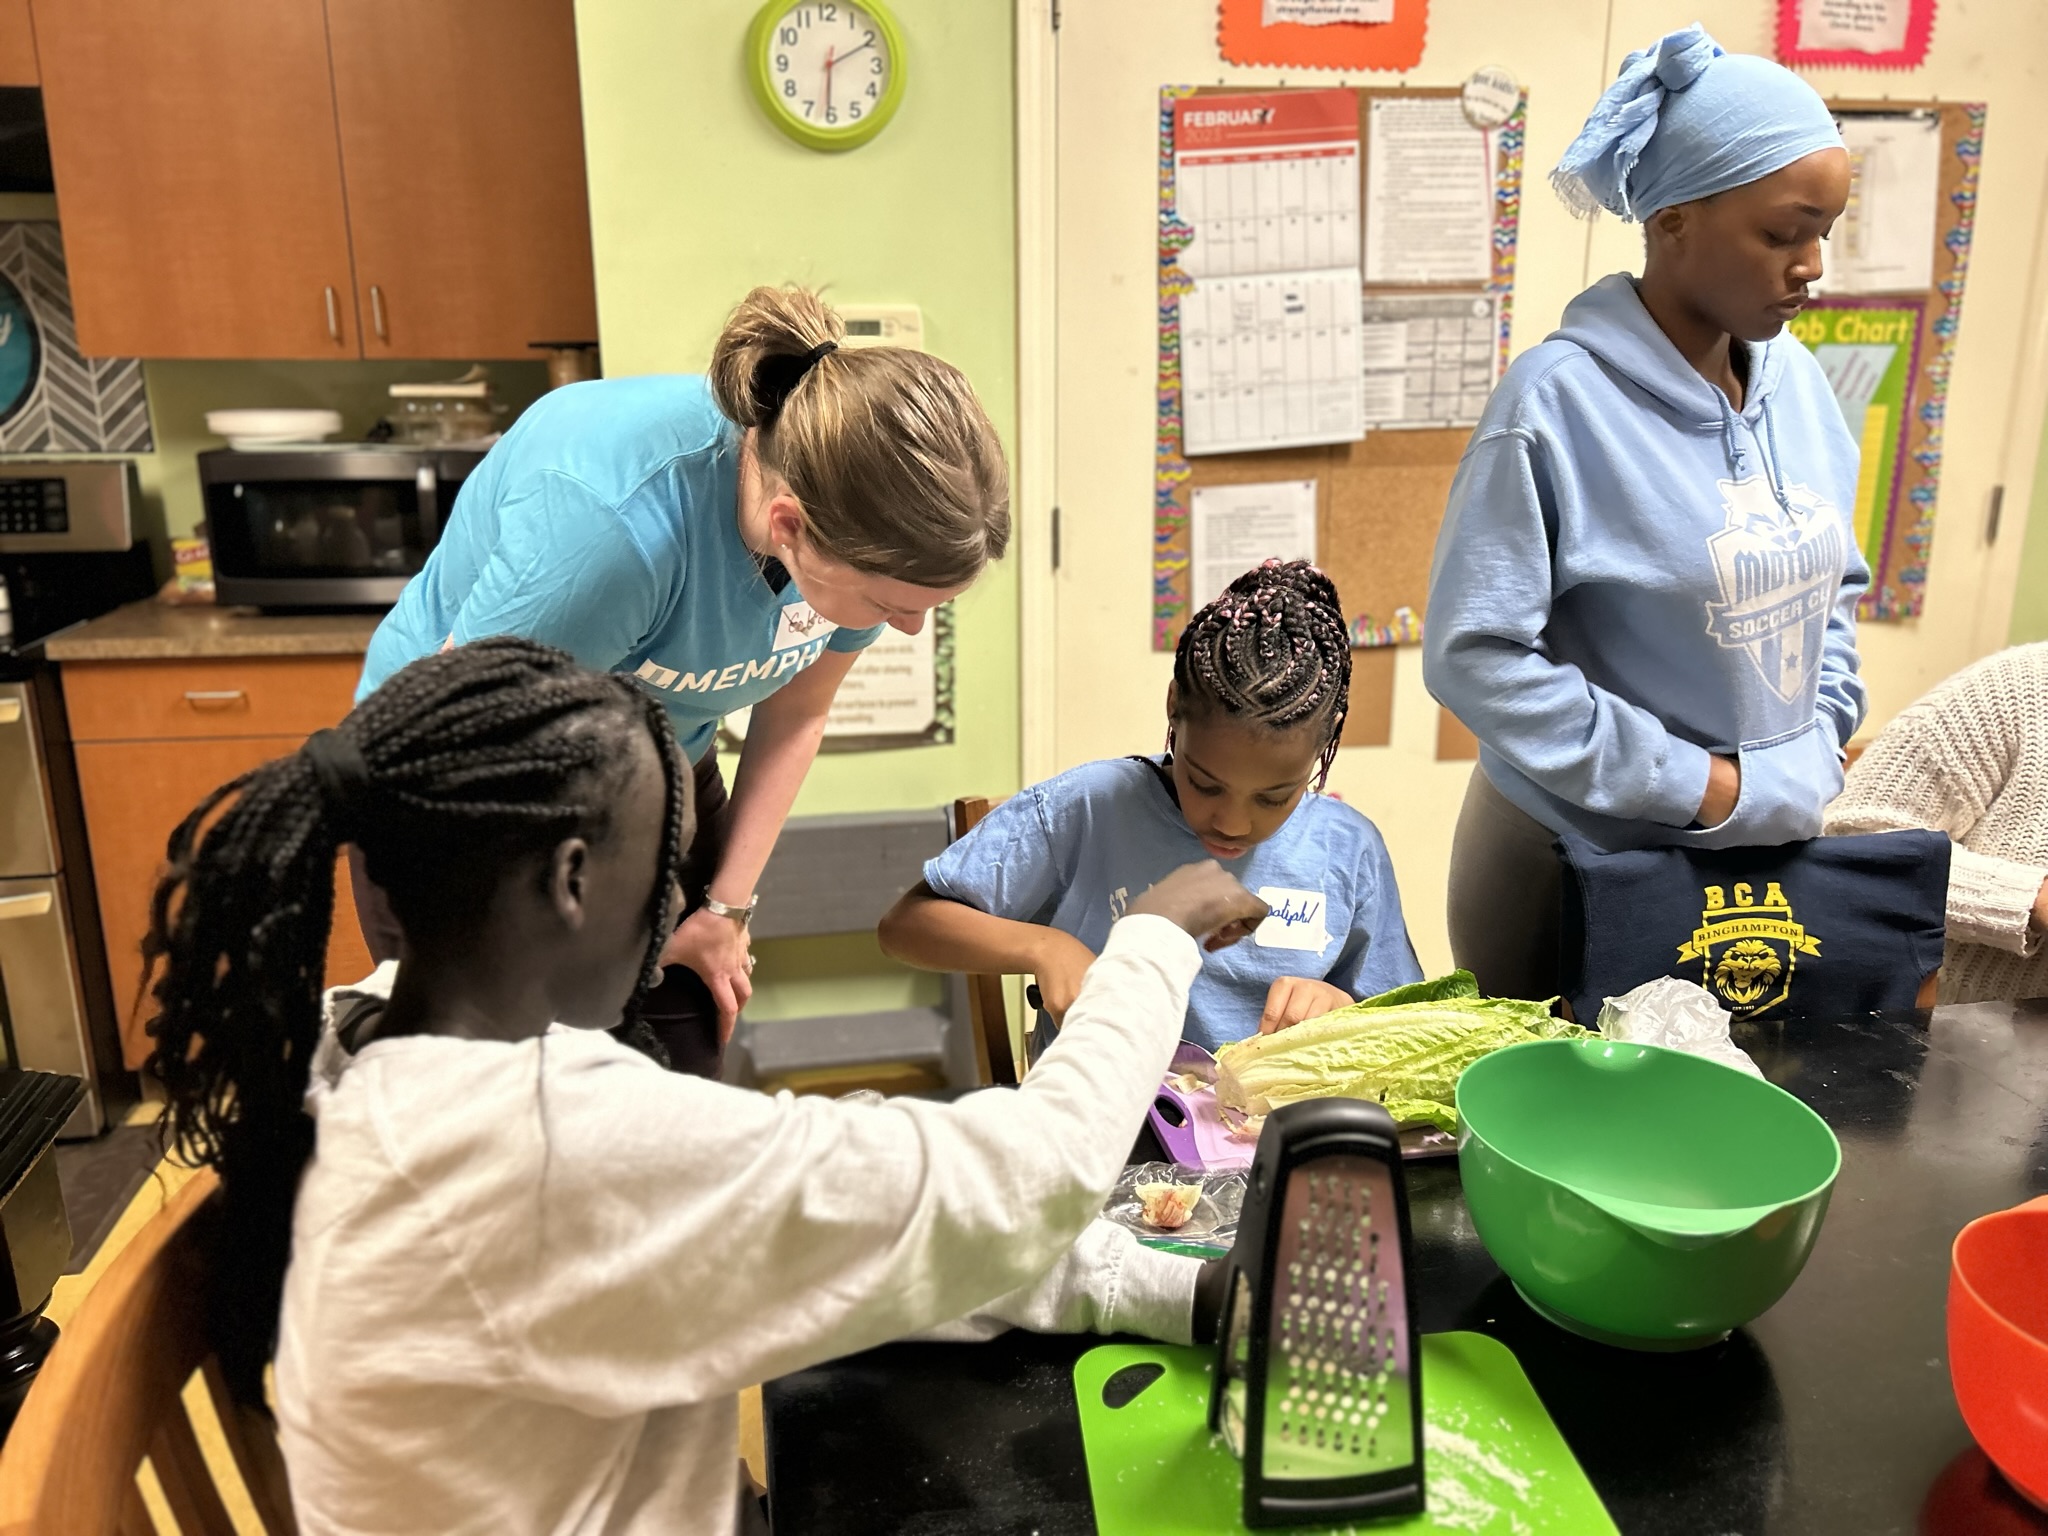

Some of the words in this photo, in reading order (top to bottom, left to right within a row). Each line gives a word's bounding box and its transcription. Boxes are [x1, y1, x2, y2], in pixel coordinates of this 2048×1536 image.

[797, 10, 810, 28] 11
[818, 3, 837, 22] 12
[849, 12, 855, 30] 1
[780, 27, 798, 46] 10
[863, 30, 876, 48] 2
[776, 54, 789, 72] 9
[870, 57, 883, 75] 3
[784, 79, 797, 97] 8
[865, 82, 877, 98] 4
[802, 100, 815, 118] 7
[826, 106, 837, 124] 6
[849, 101, 862, 119] 5
[1787, 314, 1826, 342] ob
[1834, 315, 1909, 343] Chart
[1729, 600, 1803, 639] SOCCER
[1808, 587, 1828, 609] CL
[1698, 923, 1799, 943] BINGHAMPTON
